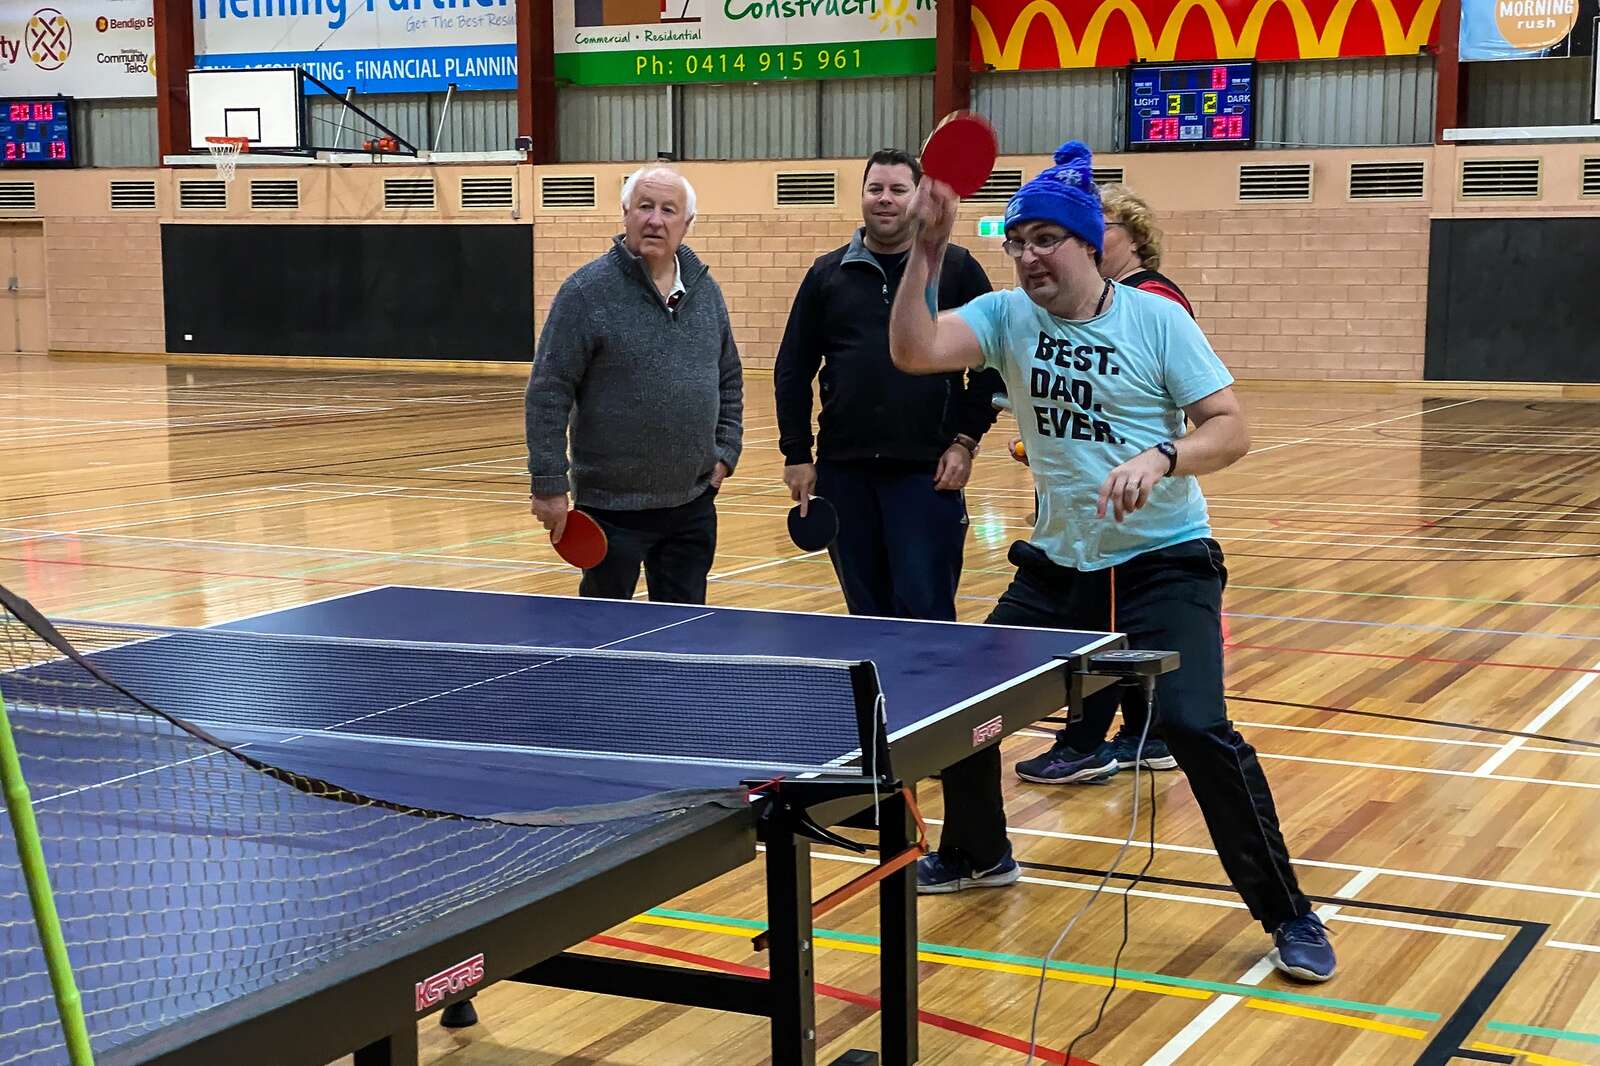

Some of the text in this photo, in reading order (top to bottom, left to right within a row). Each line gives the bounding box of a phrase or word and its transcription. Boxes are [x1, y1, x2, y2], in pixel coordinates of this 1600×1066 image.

[1500, 0, 1574, 17] MORNING
[110, 18, 145, 30] Bendigo
[432, 16, 453, 29] The
[456, 14, 483, 28] Best
[1517, 18, 1556, 29] rush
[575, 29, 701, 45] Commercial Residential
[97, 52, 148, 64] Community
[636, 49, 860, 76] Ph: 0414 915 961
[125, 63, 148, 73] Telco
[355, 58, 441, 80] FINANCIAL
[1134, 98, 1159, 106] LIGHT
[1168, 93, 1217, 115] 3 2
[1227, 95, 1250, 103] DARK
[1150, 118, 1179, 140] 20
[1213, 116, 1242, 138] 20
[1034, 331, 1119, 375] BEST.
[1031, 367, 1102, 412] DAD.
[1034, 406, 1126, 444] EVER.
